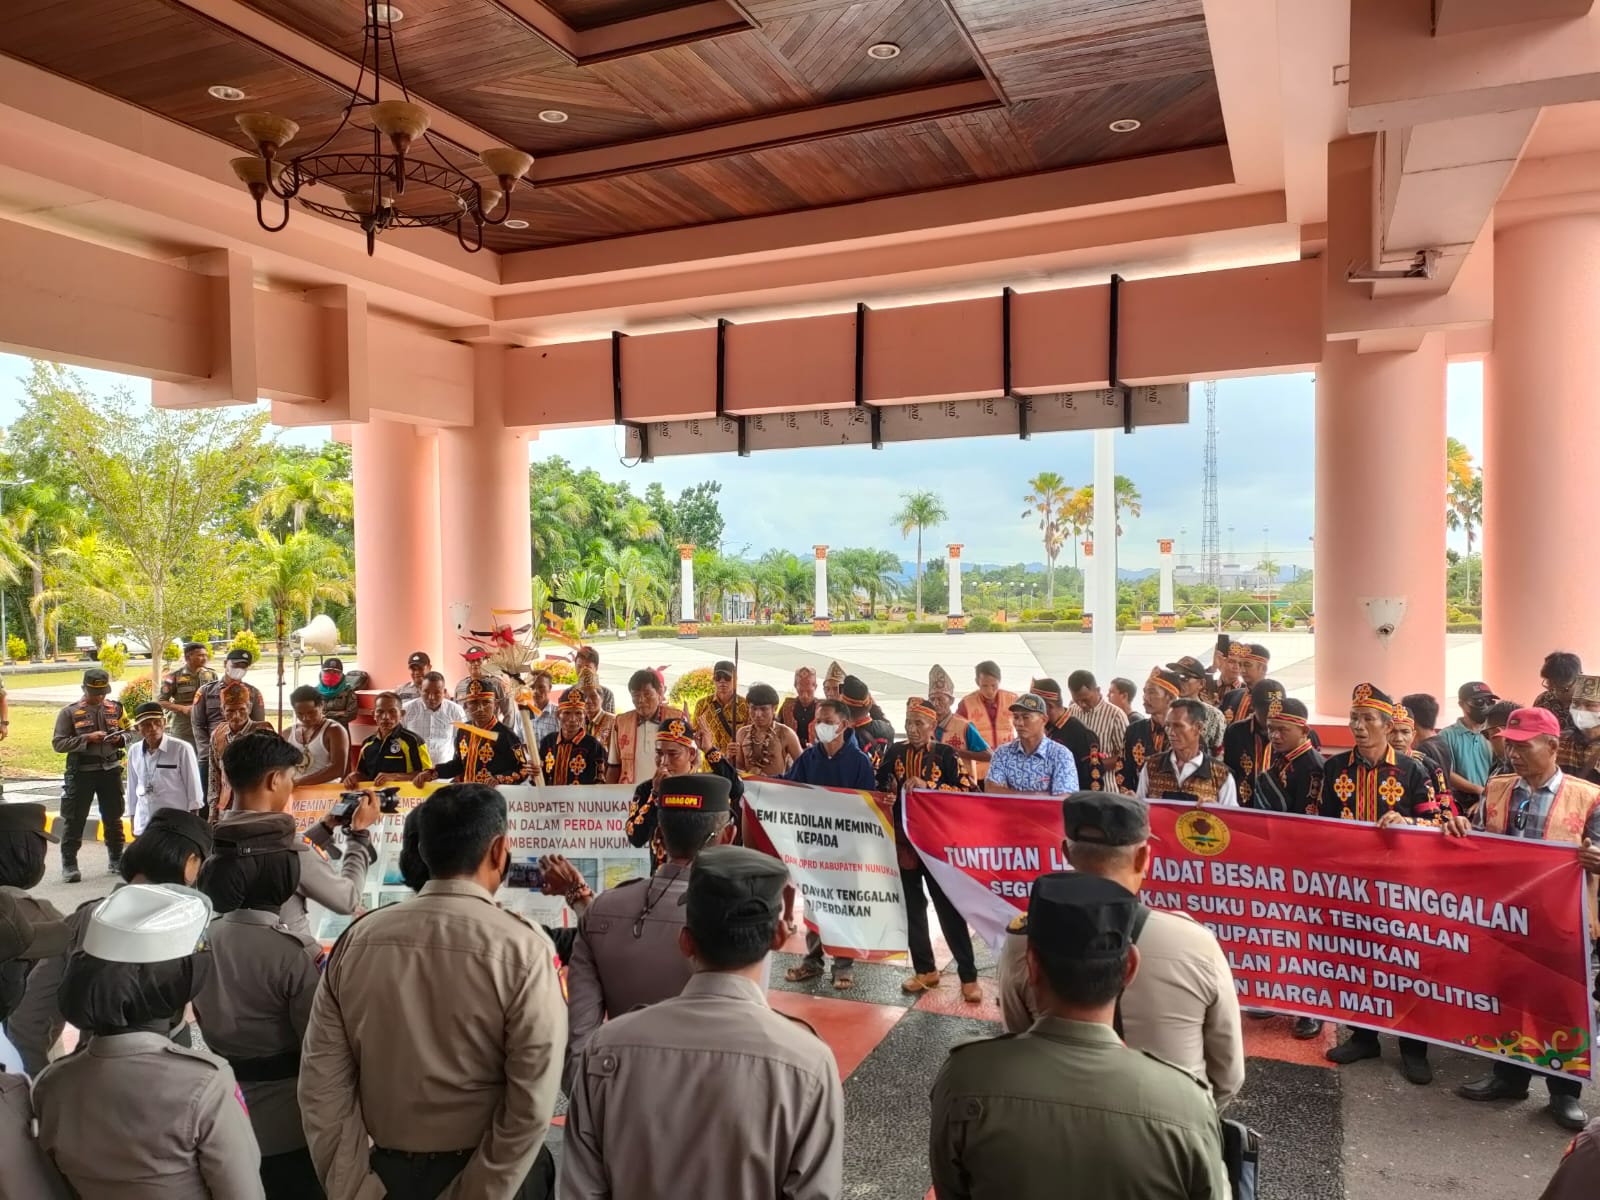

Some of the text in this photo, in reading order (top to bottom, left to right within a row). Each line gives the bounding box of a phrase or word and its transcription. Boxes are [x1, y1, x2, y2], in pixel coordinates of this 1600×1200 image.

[508, 800, 632, 813] KABUPATEN NUNUKA
[520, 818, 560, 831] DALAM
[563, 819, 603, 831] PERDA
[780, 811, 832, 830] KEADILAN
[835, 818, 885, 838] MEMINTA
[508, 837, 586, 849] MBERDAYAAN
[589, 837, 632, 849] HUKUM
[796, 830, 839, 848] KEPADA
[798, 859, 818, 869] DPRD
[819, 861, 863, 872] KABUPATEN
[864, 863, 899, 878] NUNUKAN
[943, 846, 1041, 871] TUNTUTAN
[801, 883, 900, 904] DAYAK TENGGALAN
[1151, 856, 1529, 936] ADAT BESAR DAYAK TENGGALAN
[1187, 894, 1245, 917] SUKU
[1251, 900, 1324, 925] DAYAK
[1328, 909, 1470, 953] TENGGALAN
[1203, 921, 1420, 970] BUPATEN NUNUKAN
[1277, 955, 1366, 985] JANGAN
[1372, 969, 1500, 1015] DIPOLITISI
[1255, 980, 1334, 1009] HARGA
[1339, 990, 1394, 1018] MATI
